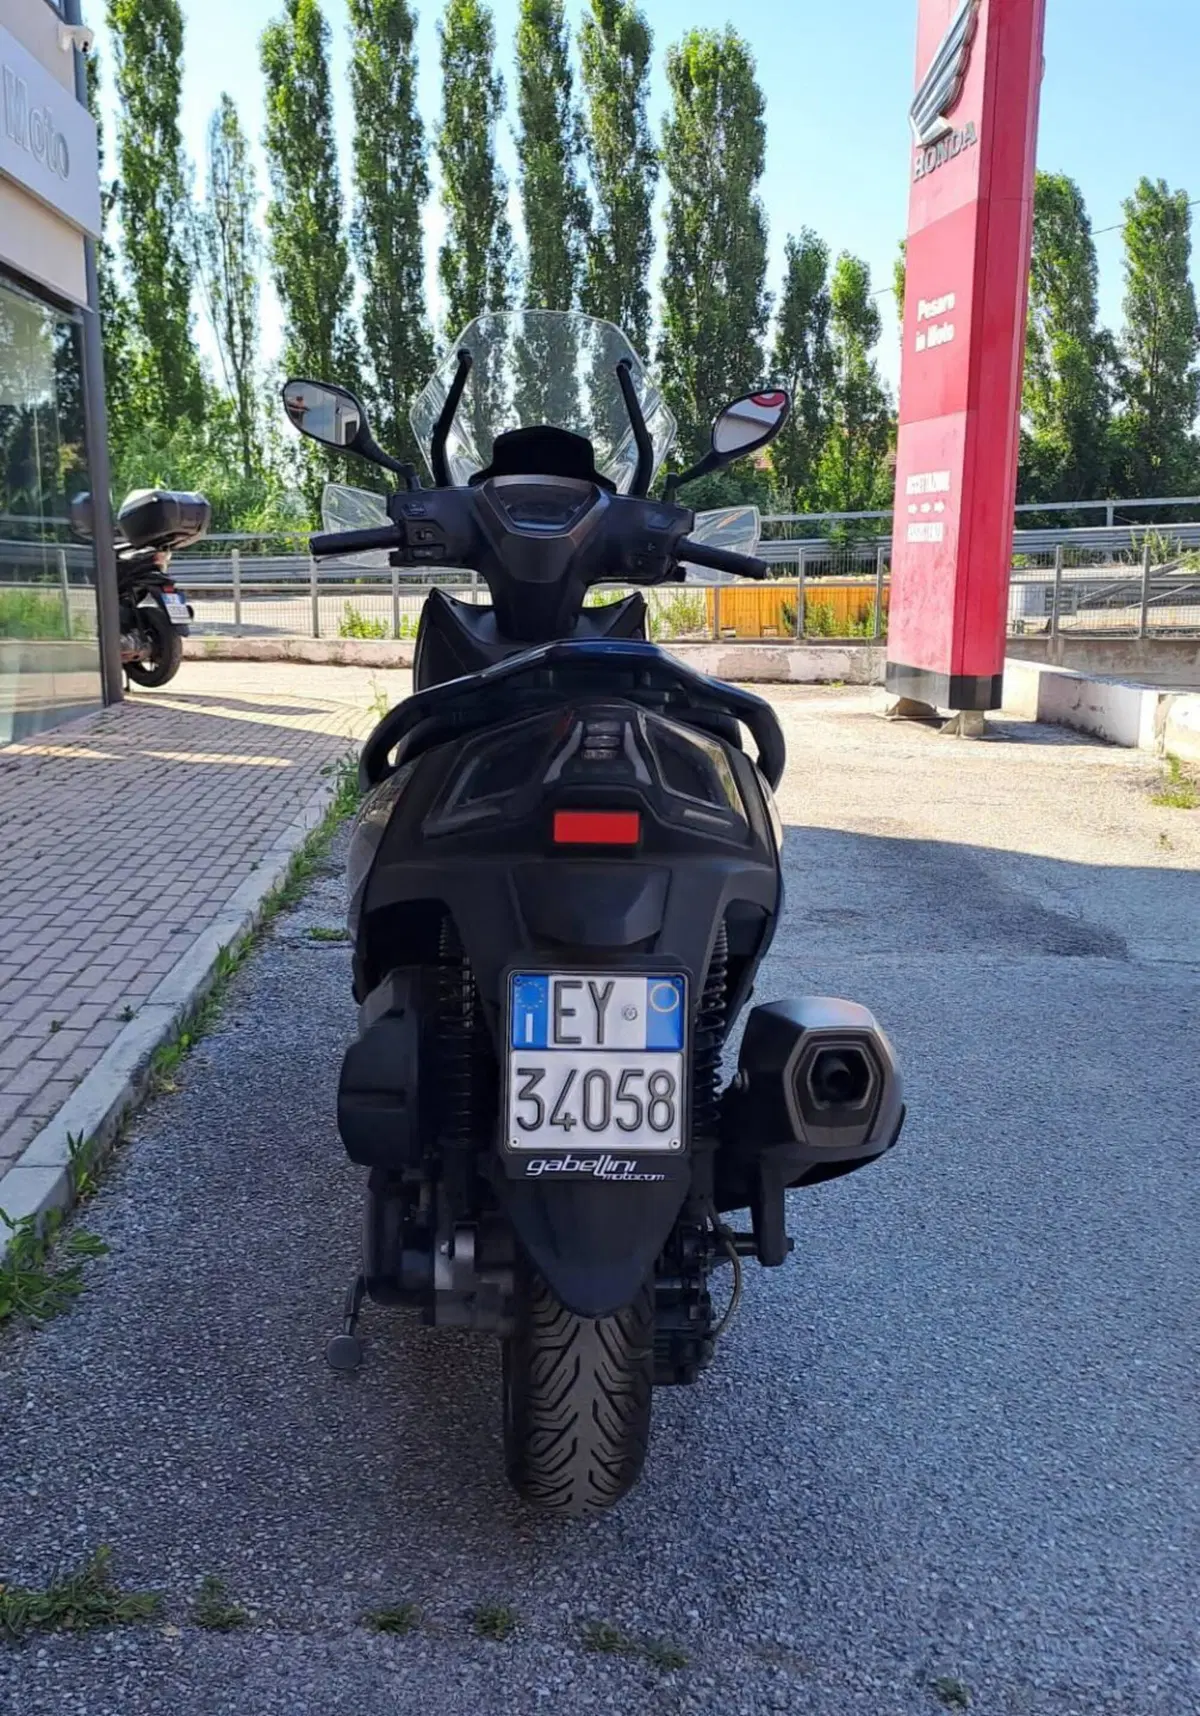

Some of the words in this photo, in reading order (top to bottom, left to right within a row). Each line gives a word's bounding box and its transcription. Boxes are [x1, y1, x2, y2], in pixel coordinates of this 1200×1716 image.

[3, 64, 69, 181] Moto
[913, 121, 978, 183] HONDA
[553, 980, 615, 1044] EY
[516, 1067, 676, 1132] 34058
[526, 1154, 637, 1177] gabellini
